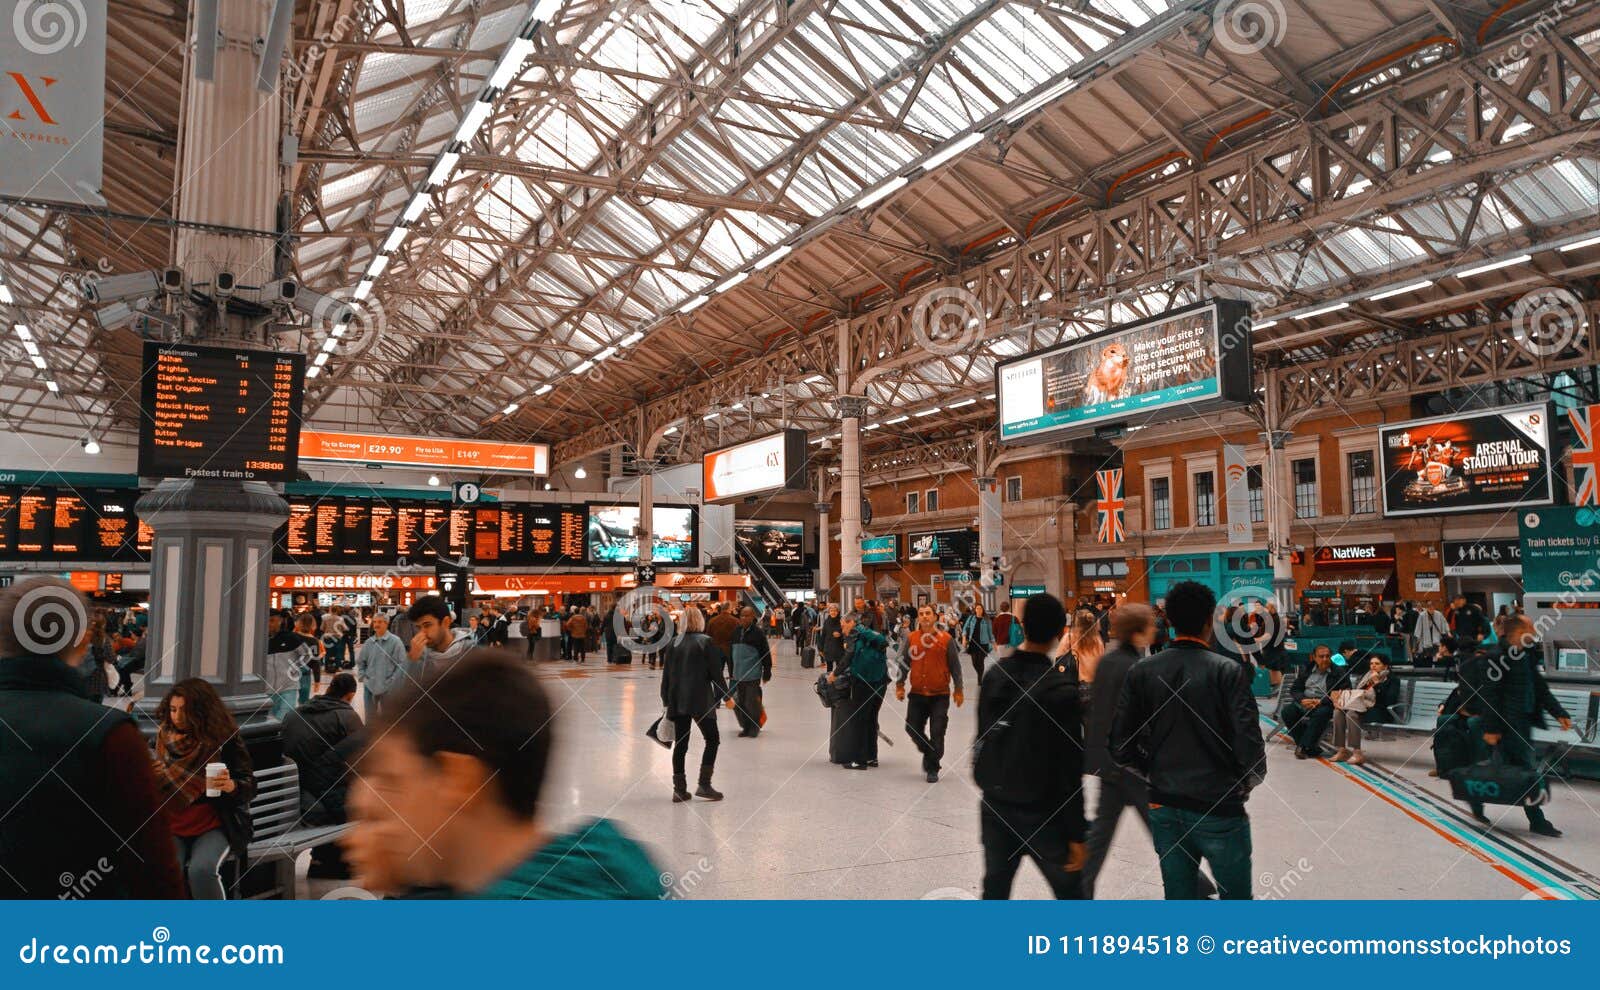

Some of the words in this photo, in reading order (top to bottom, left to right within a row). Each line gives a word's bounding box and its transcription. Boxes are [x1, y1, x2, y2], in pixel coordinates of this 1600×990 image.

[1133, 340, 1156, 352] Make
[1157, 335, 1176, 348] your
[1177, 330, 1193, 341] site
[1194, 326, 1204, 335] to
[158, 348, 198, 357] Destination
[1134, 353, 1149, 363] site
[1150, 339, 1200, 358] connections
[1134, 362, 1156, 374] more
[1157, 354, 1185, 368] secure
[1186, 347, 1206, 360] with
[158, 364, 189, 373] Brighton
[1142, 369, 1171, 384] Spitfire
[1172, 363, 1191, 375] VPN
[187, 376, 217, 385] Junction
[156, 382, 173, 391] East
[174, 384, 203, 393] Croydon
[155, 401, 182, 410] Gatwick
[184, 403, 210, 411] Airport
[189, 412, 209, 421] Heath
[154, 438, 174, 446] Three
[176, 440, 203, 448] Bridges
[339, 441, 361, 449] Europe
[1476, 439, 1523, 456] ARSENAL
[245, 460, 284, 470] 13:38:00
[1463, 454, 1508, 470] STADIUM
[1510, 449, 1539, 465] TOUR
[184, 466, 220, 477] Fastest
[222, 469, 243, 478] train
[1528, 538, 1546, 548] Train
[1547, 536, 1575, 547] tickets
[1576, 535, 1591, 547] buy
[1332, 546, 1376, 559] NatWest
[294, 576, 354, 588] BURGER
[356, 576, 393, 588] KING
[1342, 578, 1386, 586] withdrawals
